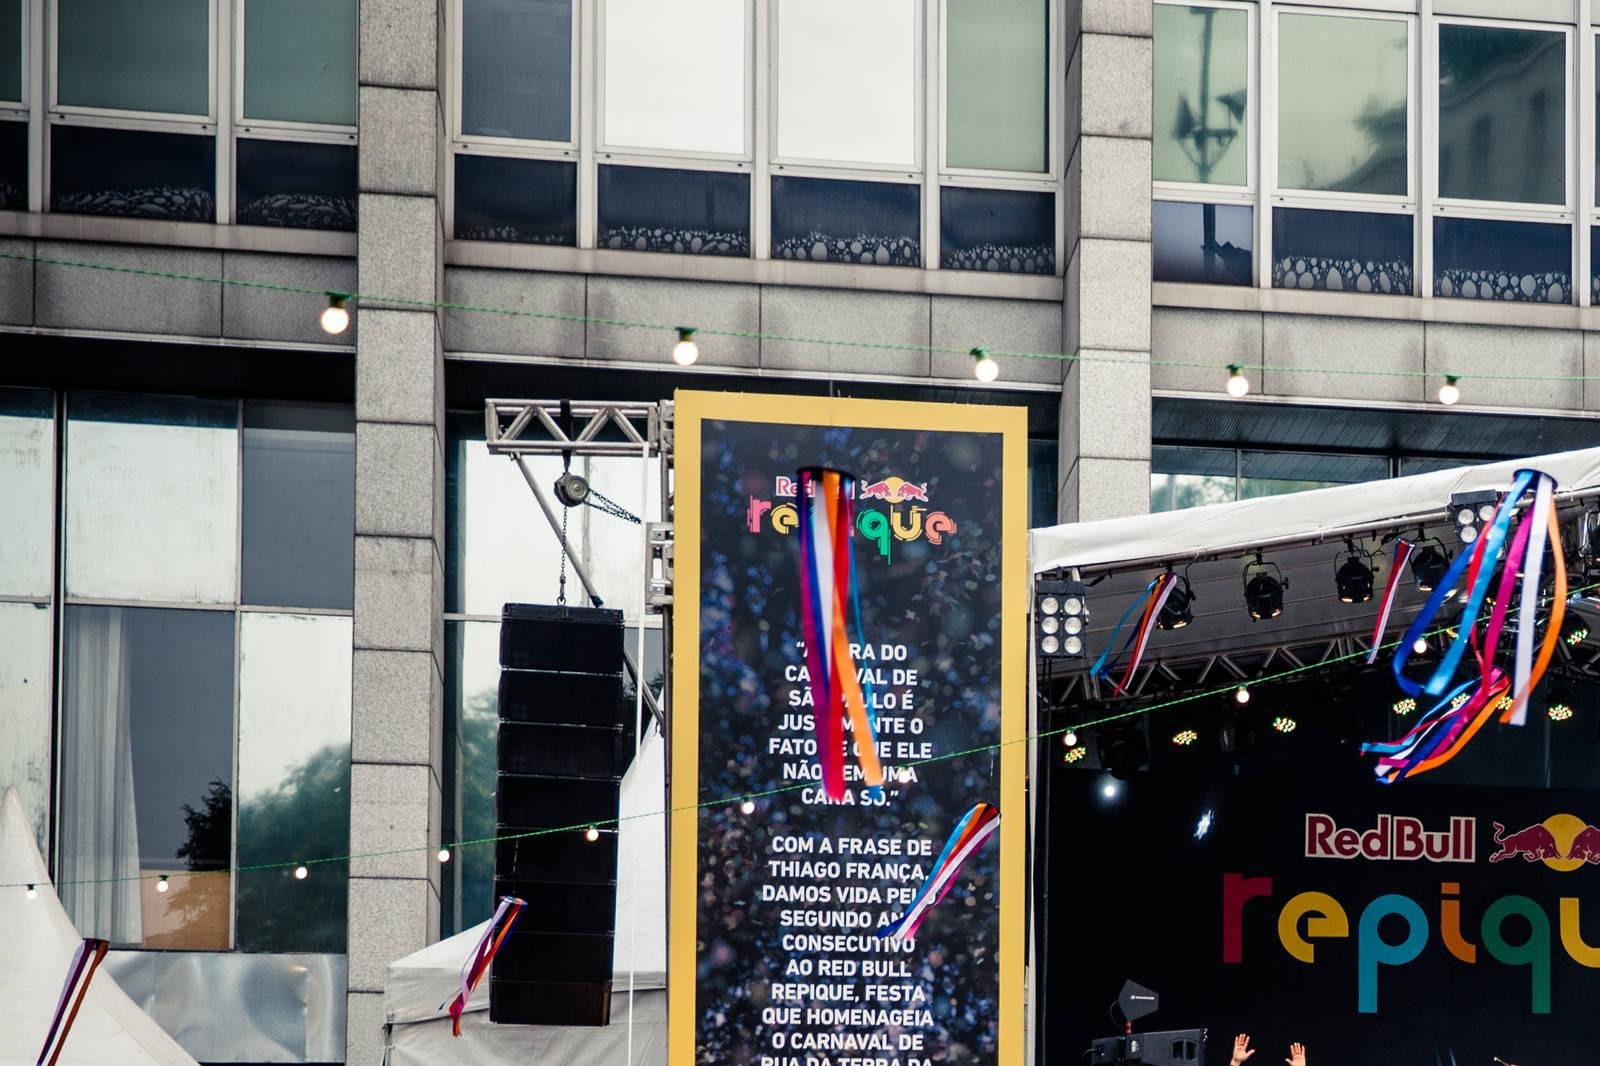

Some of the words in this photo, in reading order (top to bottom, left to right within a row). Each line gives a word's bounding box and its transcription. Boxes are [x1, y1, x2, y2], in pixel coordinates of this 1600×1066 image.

[881, 645, 907, 661] DO
[785, 665, 888, 685] CAVAL
[893, 669, 918, 686] DE
[788, 686, 815, 707] SÃ
[902, 689, 914, 710] É
[910, 718, 924, 734] O
[769, 738, 817, 756] FATO
[897, 742, 932, 759] ELE
[783, 759, 823, 780] NÃO
[772, 836, 814, 854] COM
[819, 838, 834, 855] A
[838, 838, 902, 856] FRASE
[907, 839, 932, 856] DE
[768, 860, 841, 878] THIAGO
[846, 862, 929, 883] FRANÇA,
[762, 885, 831, 902] DAMOS
[836, 886, 882, 904] VIDA
[780, 910, 872, 928] SEGUNDO
[877, 912, 905, 928] AN
[782, 934, 915, 953] CONSECUTIVO
[786, 959, 813, 977] AO
[818, 960, 857, 977] RED
[862, 961, 912, 977] BULL
[771, 983, 860, 1003] REPIQUE,
[865, 985, 926, 1002] FESTA
[762, 1008, 801, 1026] QUE
[806, 1009, 934, 1027] HOMENAGEIA
[772, 1032, 785, 1049] O
[790, 1032, 894, 1051] CARNAVAL
[899, 1034, 924, 1051] DE
